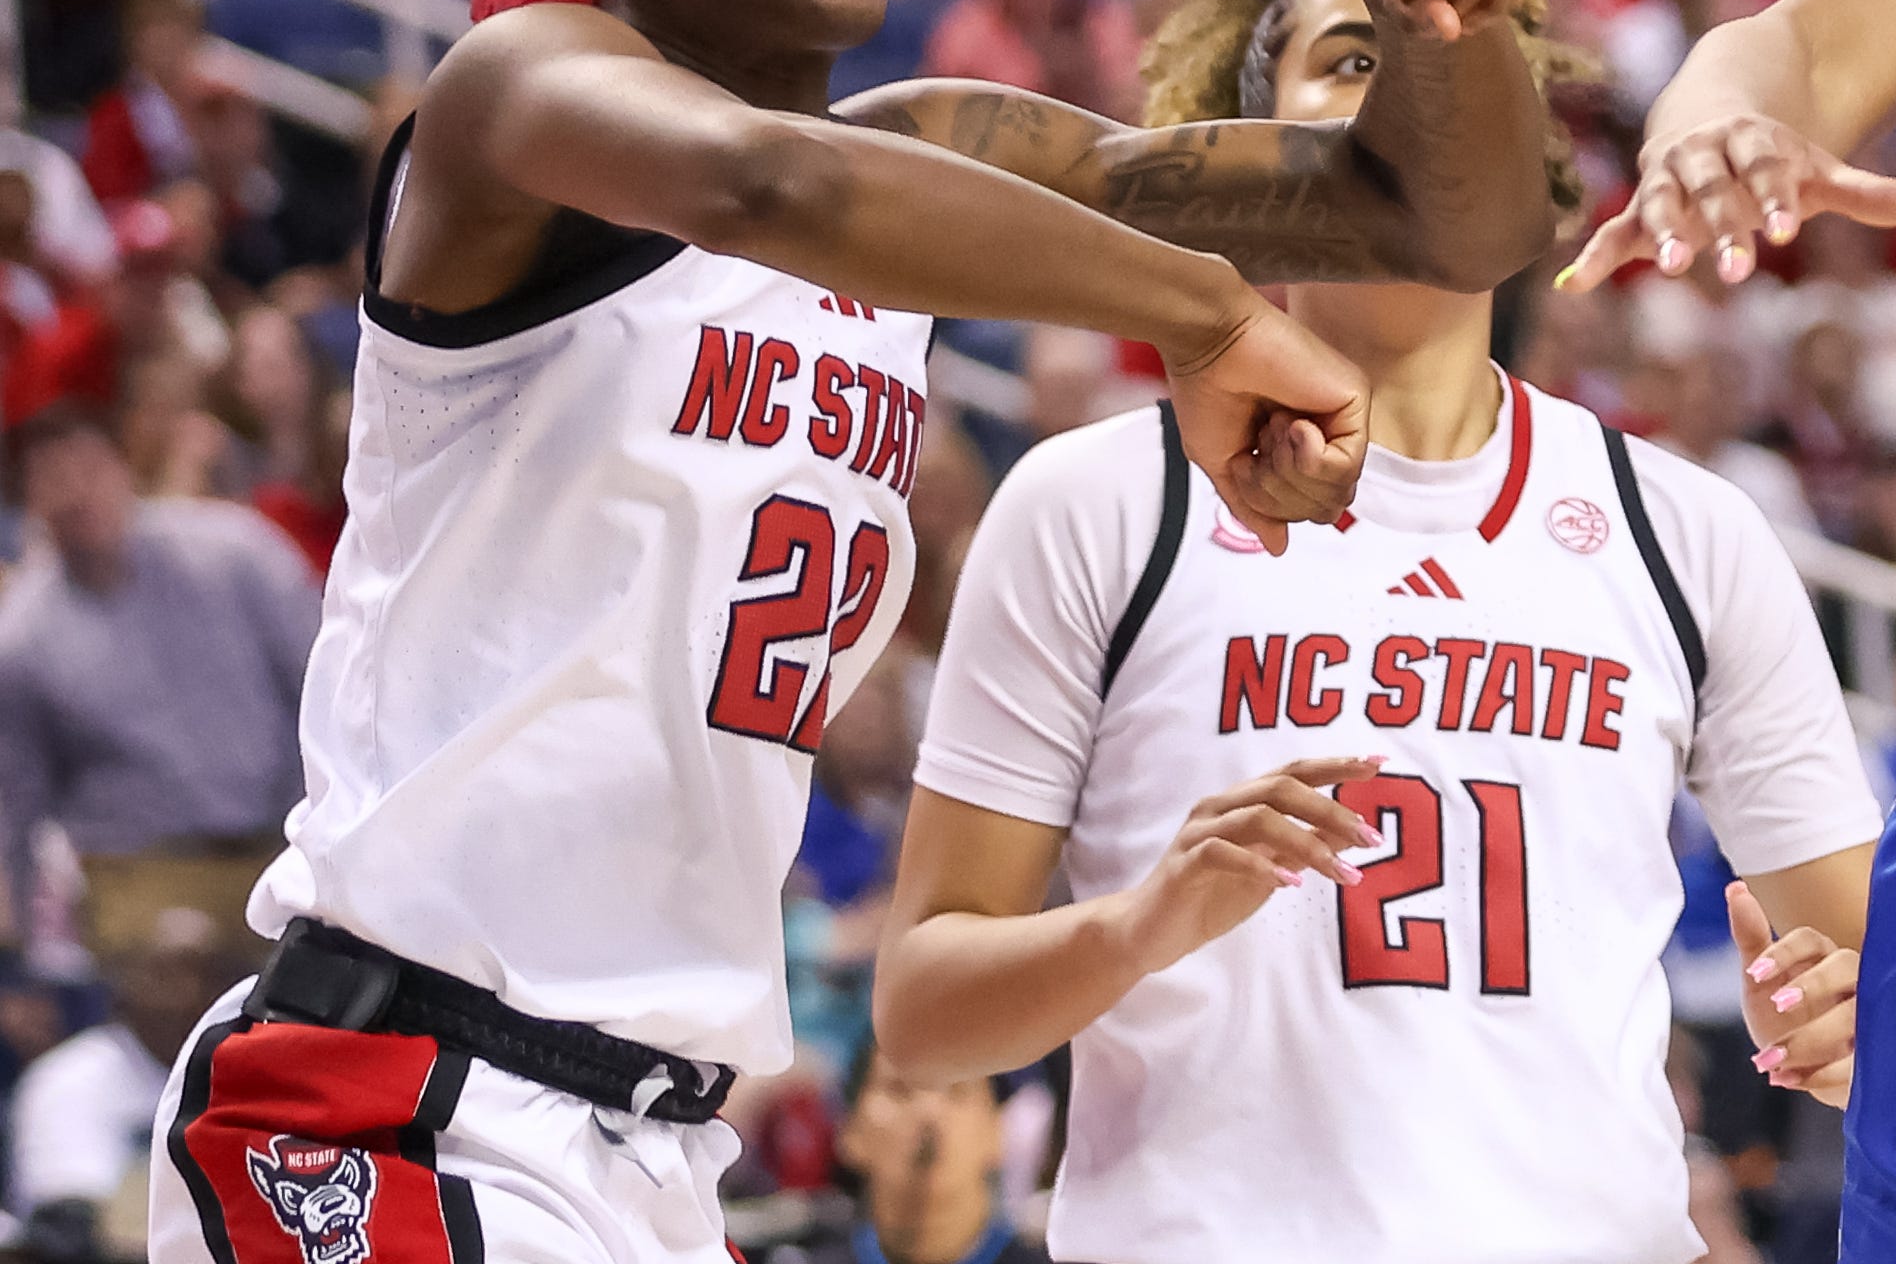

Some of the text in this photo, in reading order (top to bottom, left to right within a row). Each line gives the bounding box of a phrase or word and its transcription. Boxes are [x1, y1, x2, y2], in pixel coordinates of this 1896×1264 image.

[671, 324, 800, 448] NC
[706, 492, 889, 754] 22
[1219, 633, 1632, 751] NC STATE
[1332, 772, 1531, 996] 21
[287, 1147, 337, 1168] NC STATE
